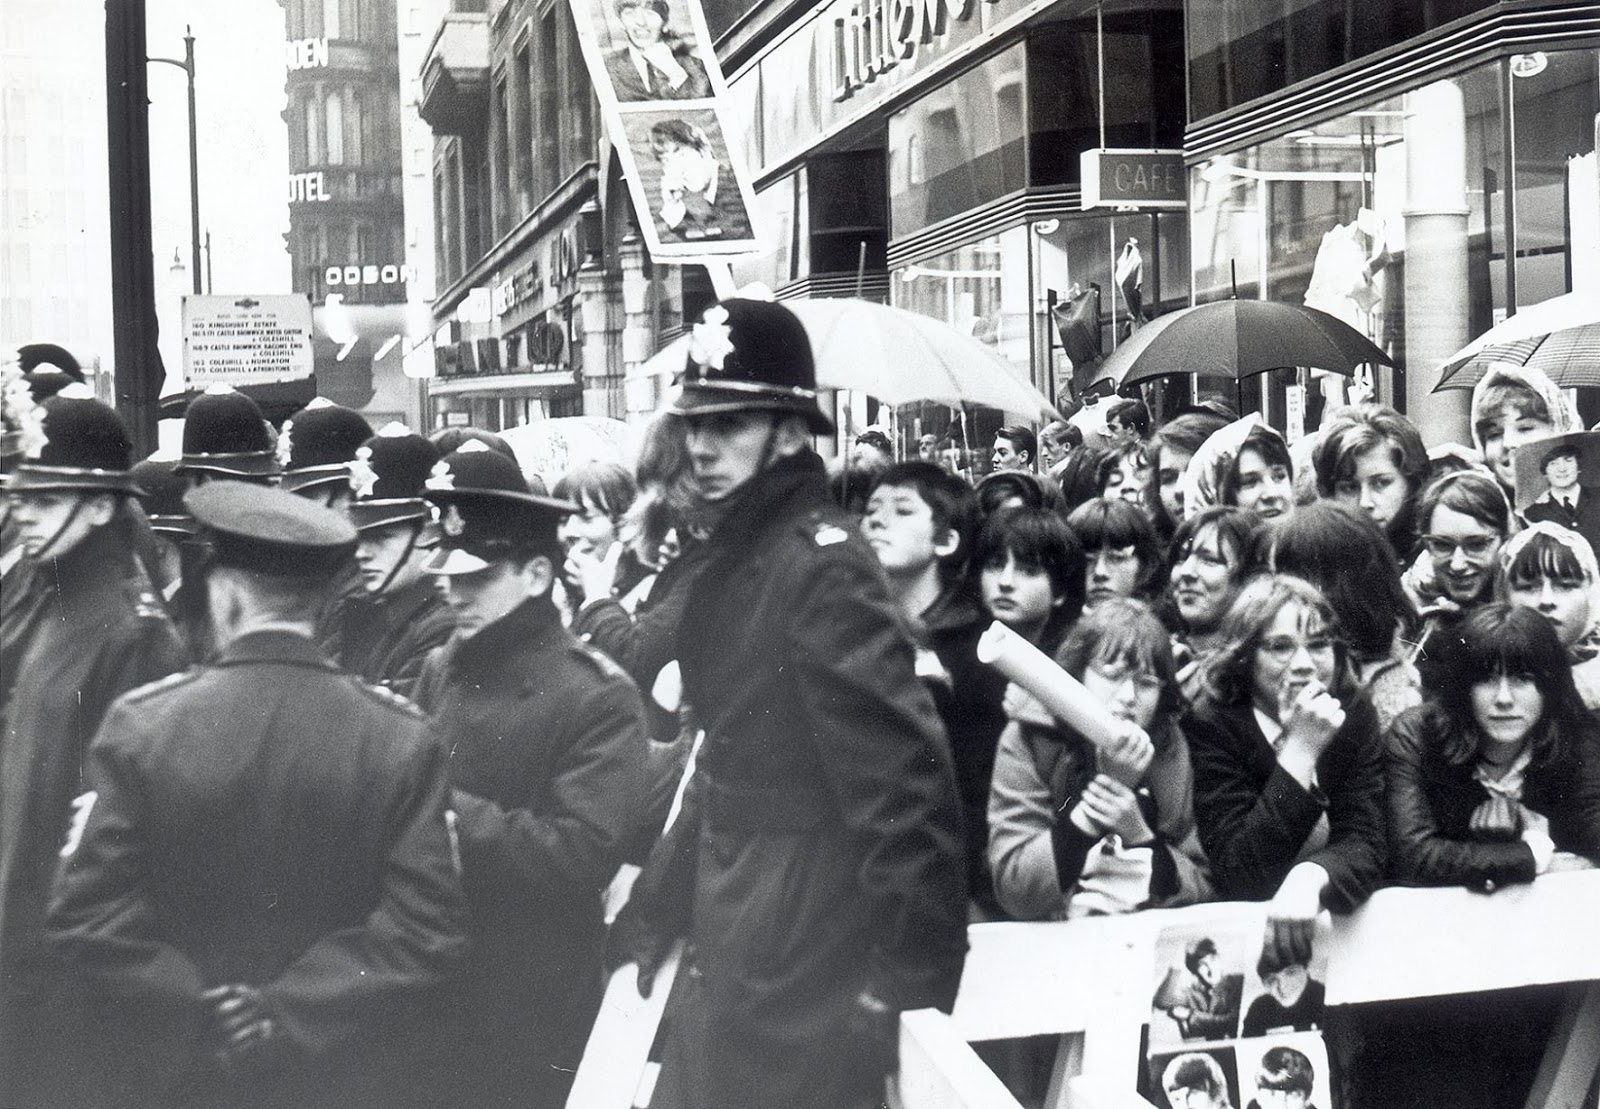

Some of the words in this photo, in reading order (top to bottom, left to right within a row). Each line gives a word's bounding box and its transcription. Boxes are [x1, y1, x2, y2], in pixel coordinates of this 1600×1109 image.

[1114, 162, 1176, 192] CAFE
[259, 335, 295, 343] COLESHILL
[211, 343, 230, 351] CASTLE
[260, 349, 295, 357] COLESHILL
[210, 358, 242, 366] COLESHILL
[251, 357, 290, 365] NUNEATON
